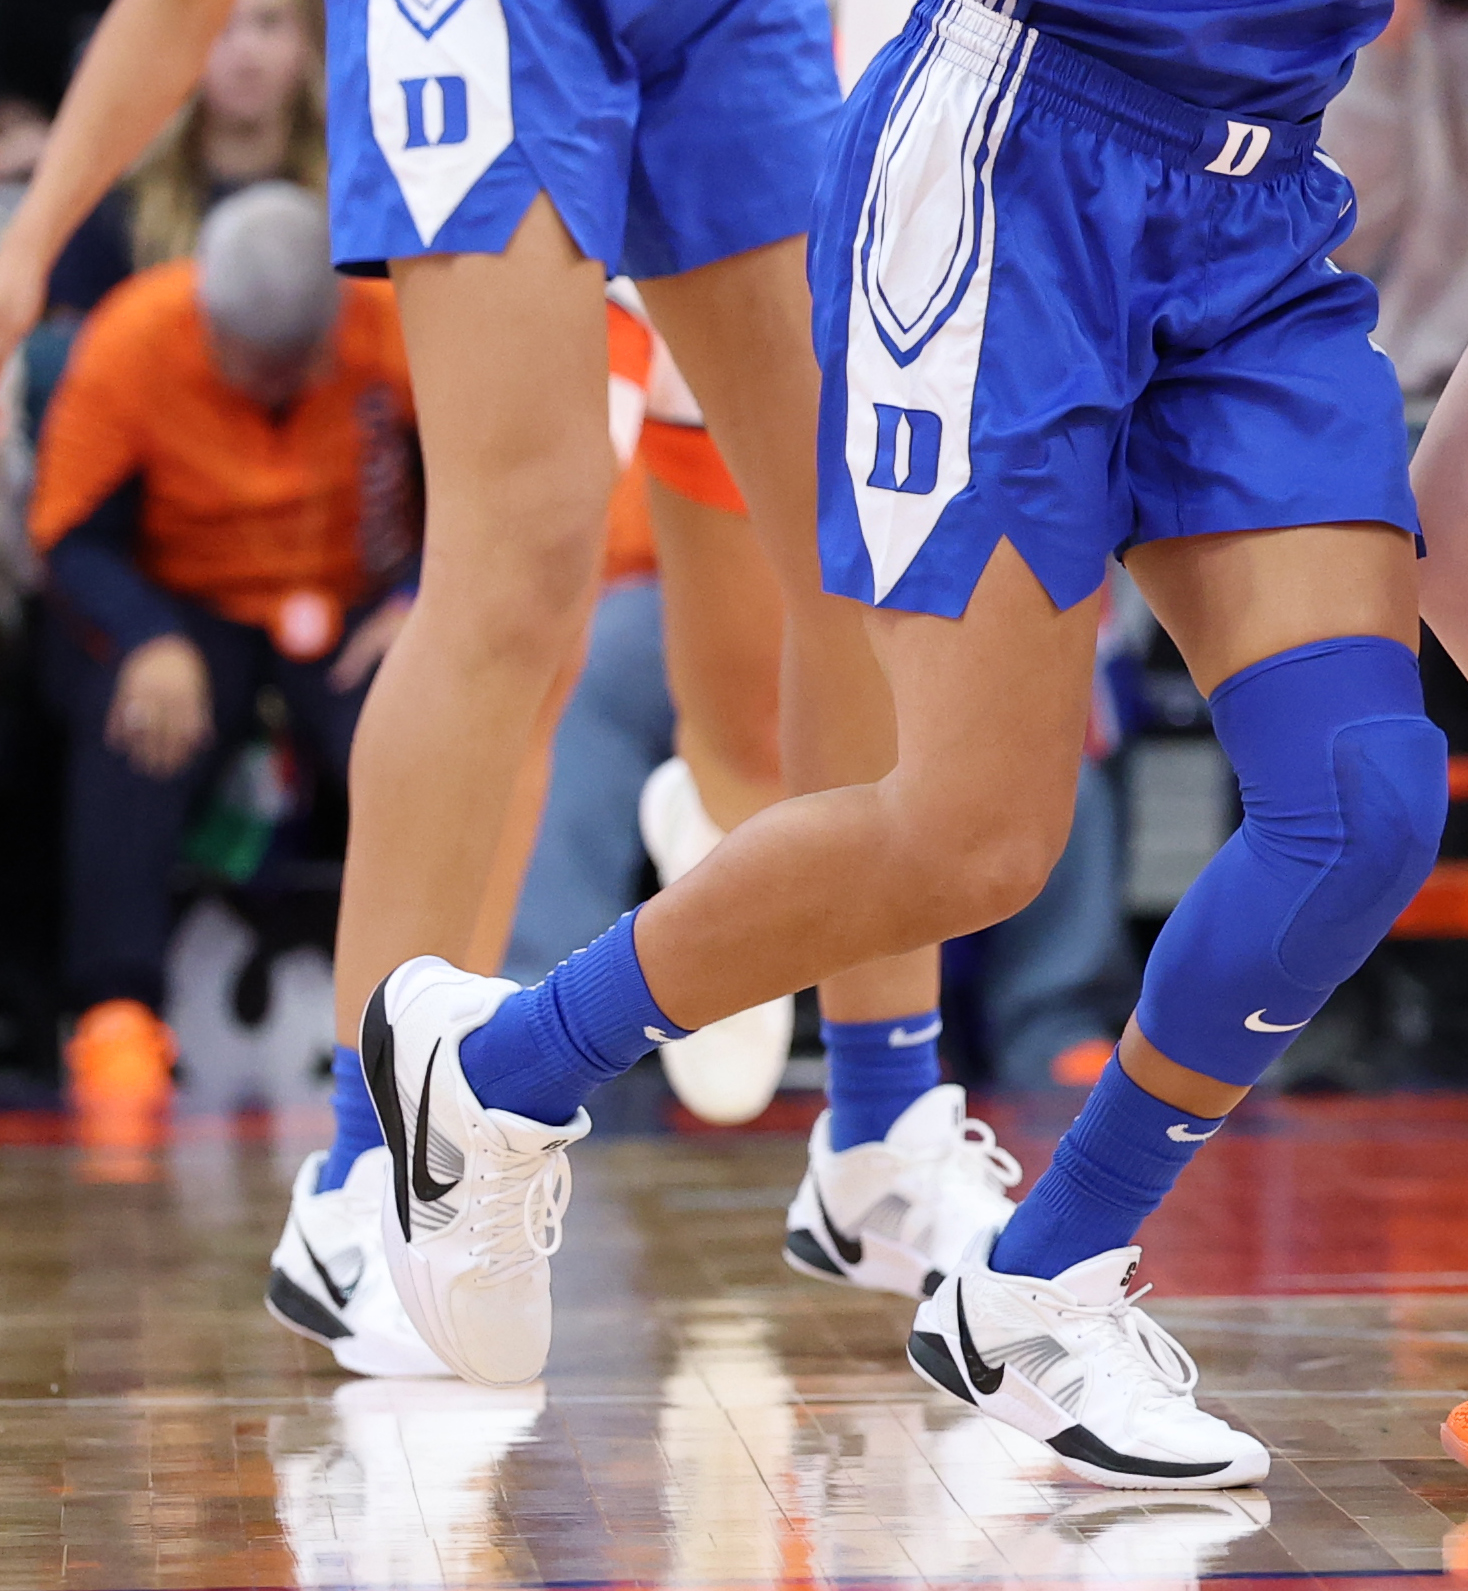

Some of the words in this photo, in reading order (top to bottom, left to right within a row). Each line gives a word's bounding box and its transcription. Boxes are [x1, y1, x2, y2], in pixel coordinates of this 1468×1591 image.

[398, 74, 470, 150] D
[1203, 120, 1272, 177] D
[866, 402, 943, 496] D
